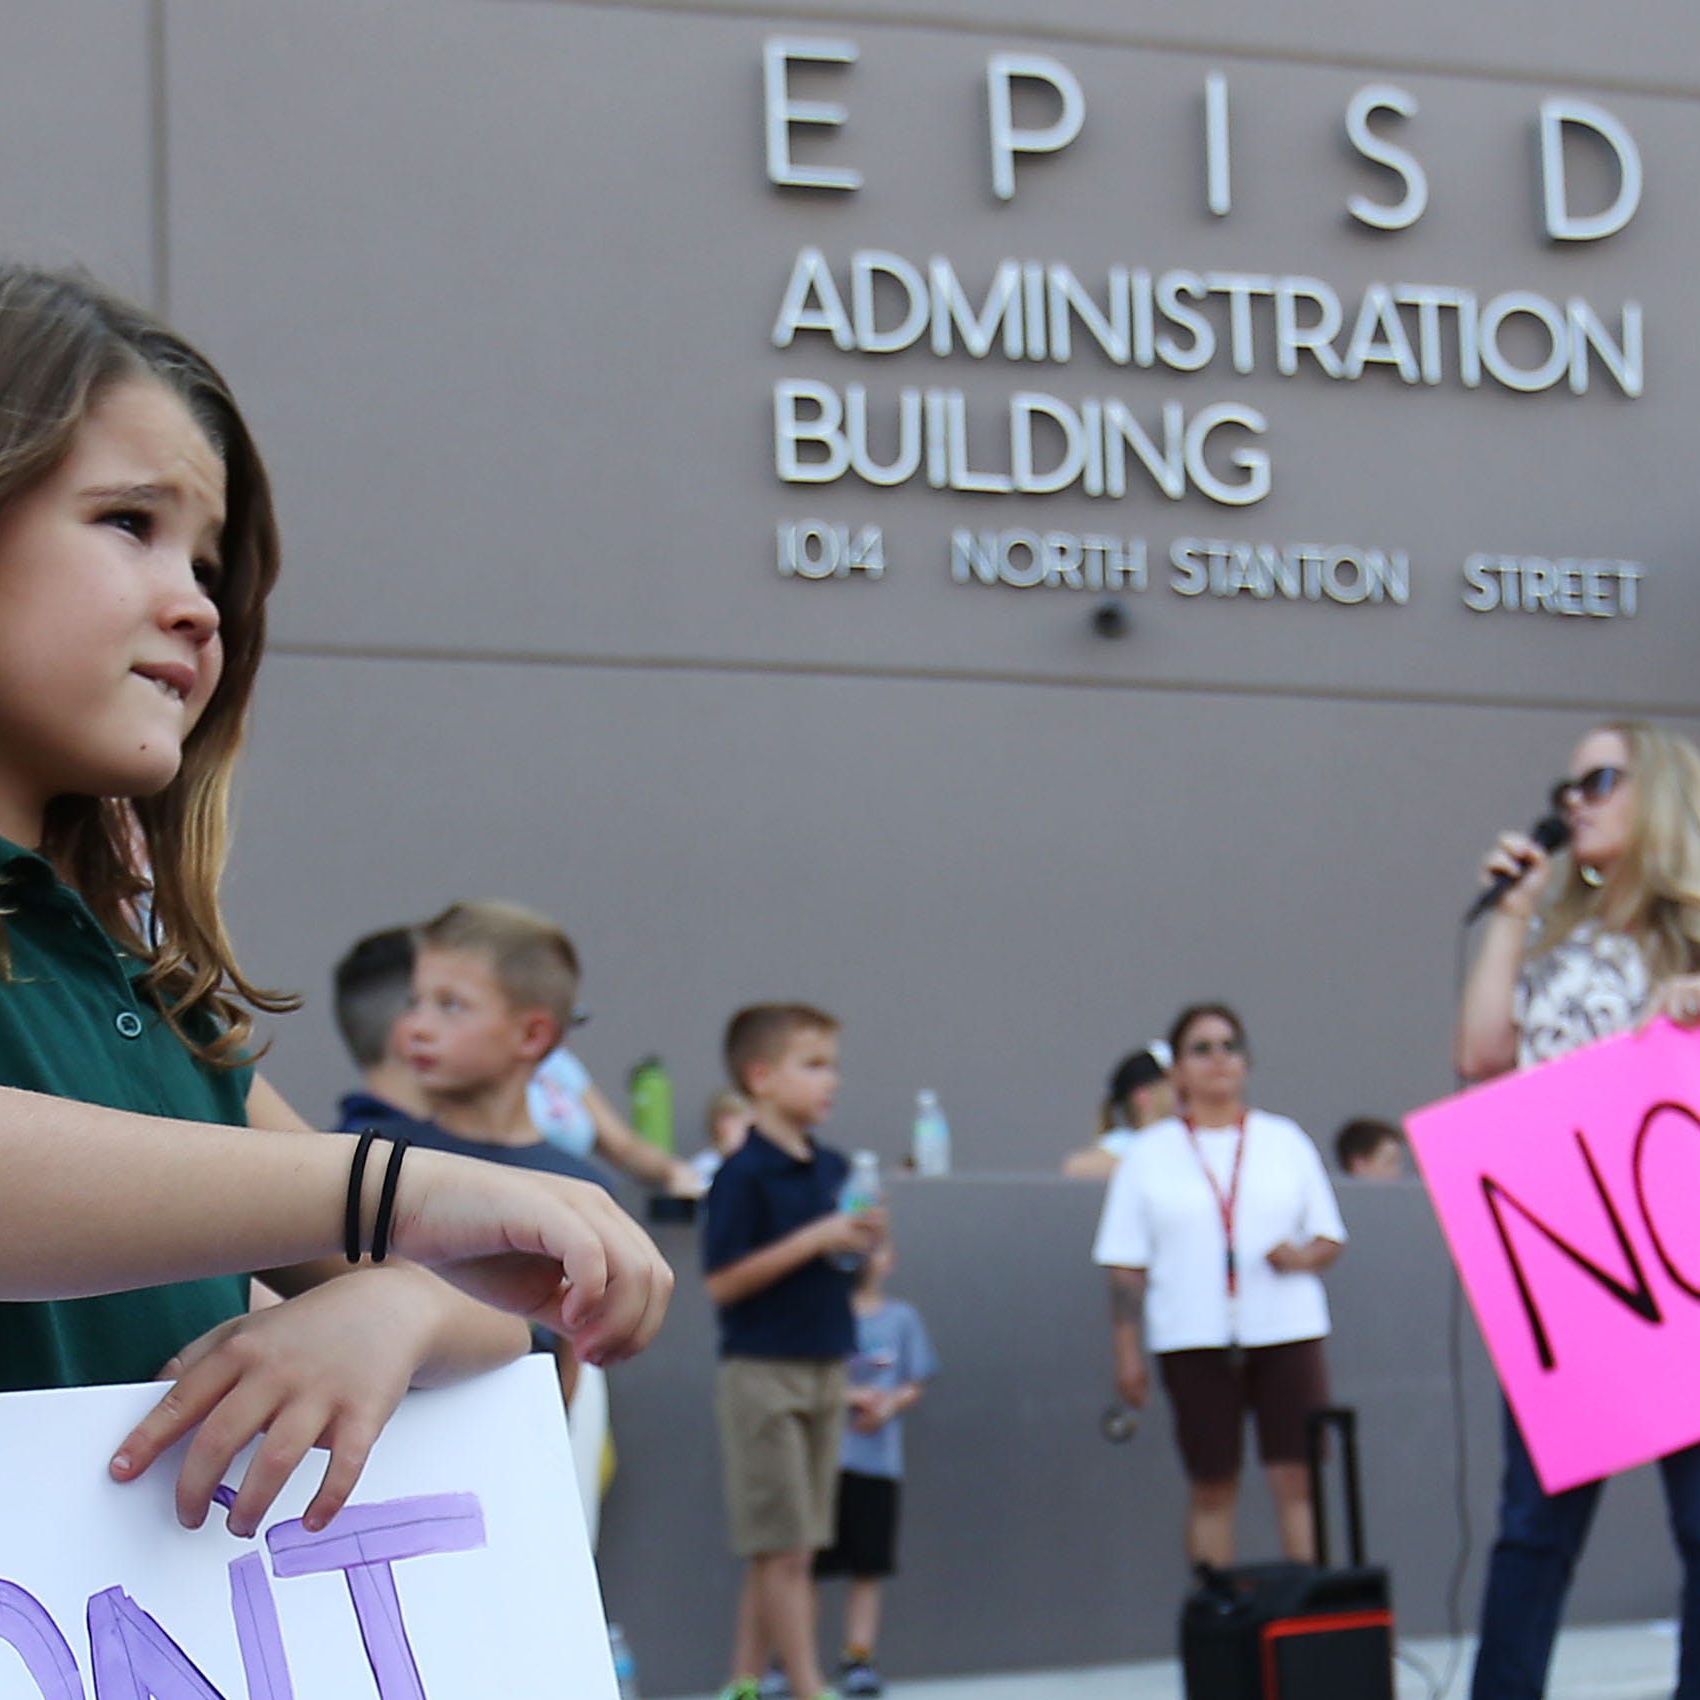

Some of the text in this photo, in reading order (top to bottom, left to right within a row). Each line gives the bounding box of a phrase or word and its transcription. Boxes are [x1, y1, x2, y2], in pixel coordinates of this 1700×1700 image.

[771, 246, 1645, 400] ADMINISTRATION
[773, 378, 1273, 507] BUILDING
[776, 518, 1646, 618] 1014 NORTH STANTON STREET
